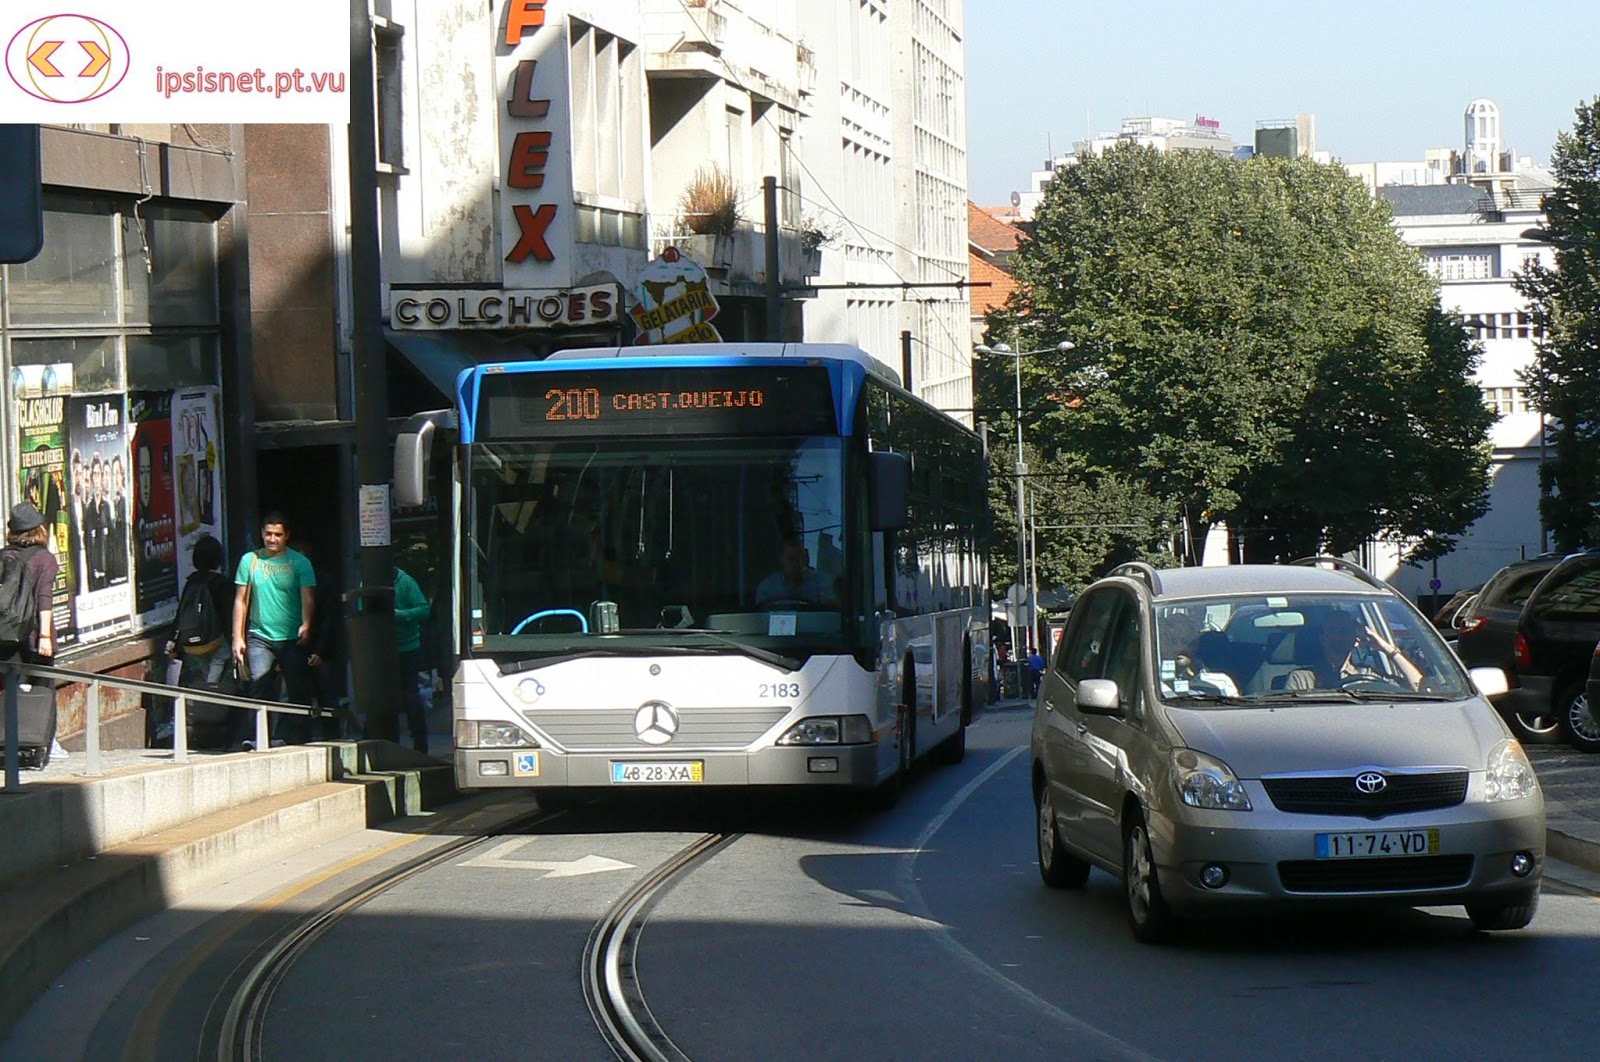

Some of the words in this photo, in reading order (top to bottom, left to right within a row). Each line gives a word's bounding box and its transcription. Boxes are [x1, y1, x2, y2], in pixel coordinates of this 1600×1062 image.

[640, 290, 711, 331] GELATARIA
[545, 388, 600, 421] 200
[759, 683, 800, 698] 2183
